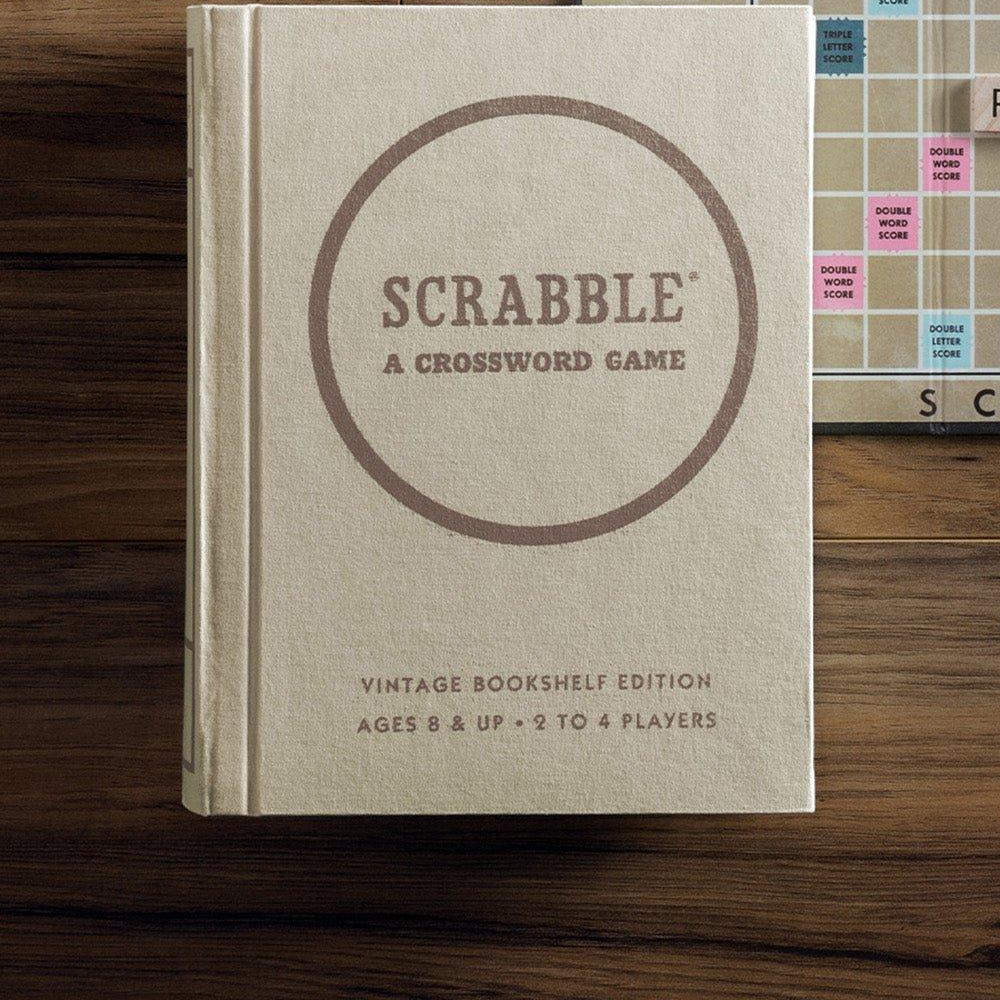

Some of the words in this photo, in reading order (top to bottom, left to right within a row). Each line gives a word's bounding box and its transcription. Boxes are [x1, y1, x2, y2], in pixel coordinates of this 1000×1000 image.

[875, 206, 912, 216] DOUBLE
[878, 219, 909, 228] WORD
[878, 231, 909, 240] SCORE
[382, 351, 405, 375] A
[414, 349, 593, 375] CROSSWORD
[604, 349, 686, 372] GAME
[361, 675, 462, 695] VINTAGE
[473, 674, 607, 693] BOOKSHELF
[617, 673, 711, 691] EDITION
[356, 715, 417, 734] AGES
[427, 715, 440, 733] 8
[450, 714, 466, 732] &
[477, 714, 504, 732] UP
[532, 713, 547, 731] 2
[556, 713, 588, 731] TO
[598, 713, 611, 730] 4
[621, 711, 717, 730] PLAYERS
